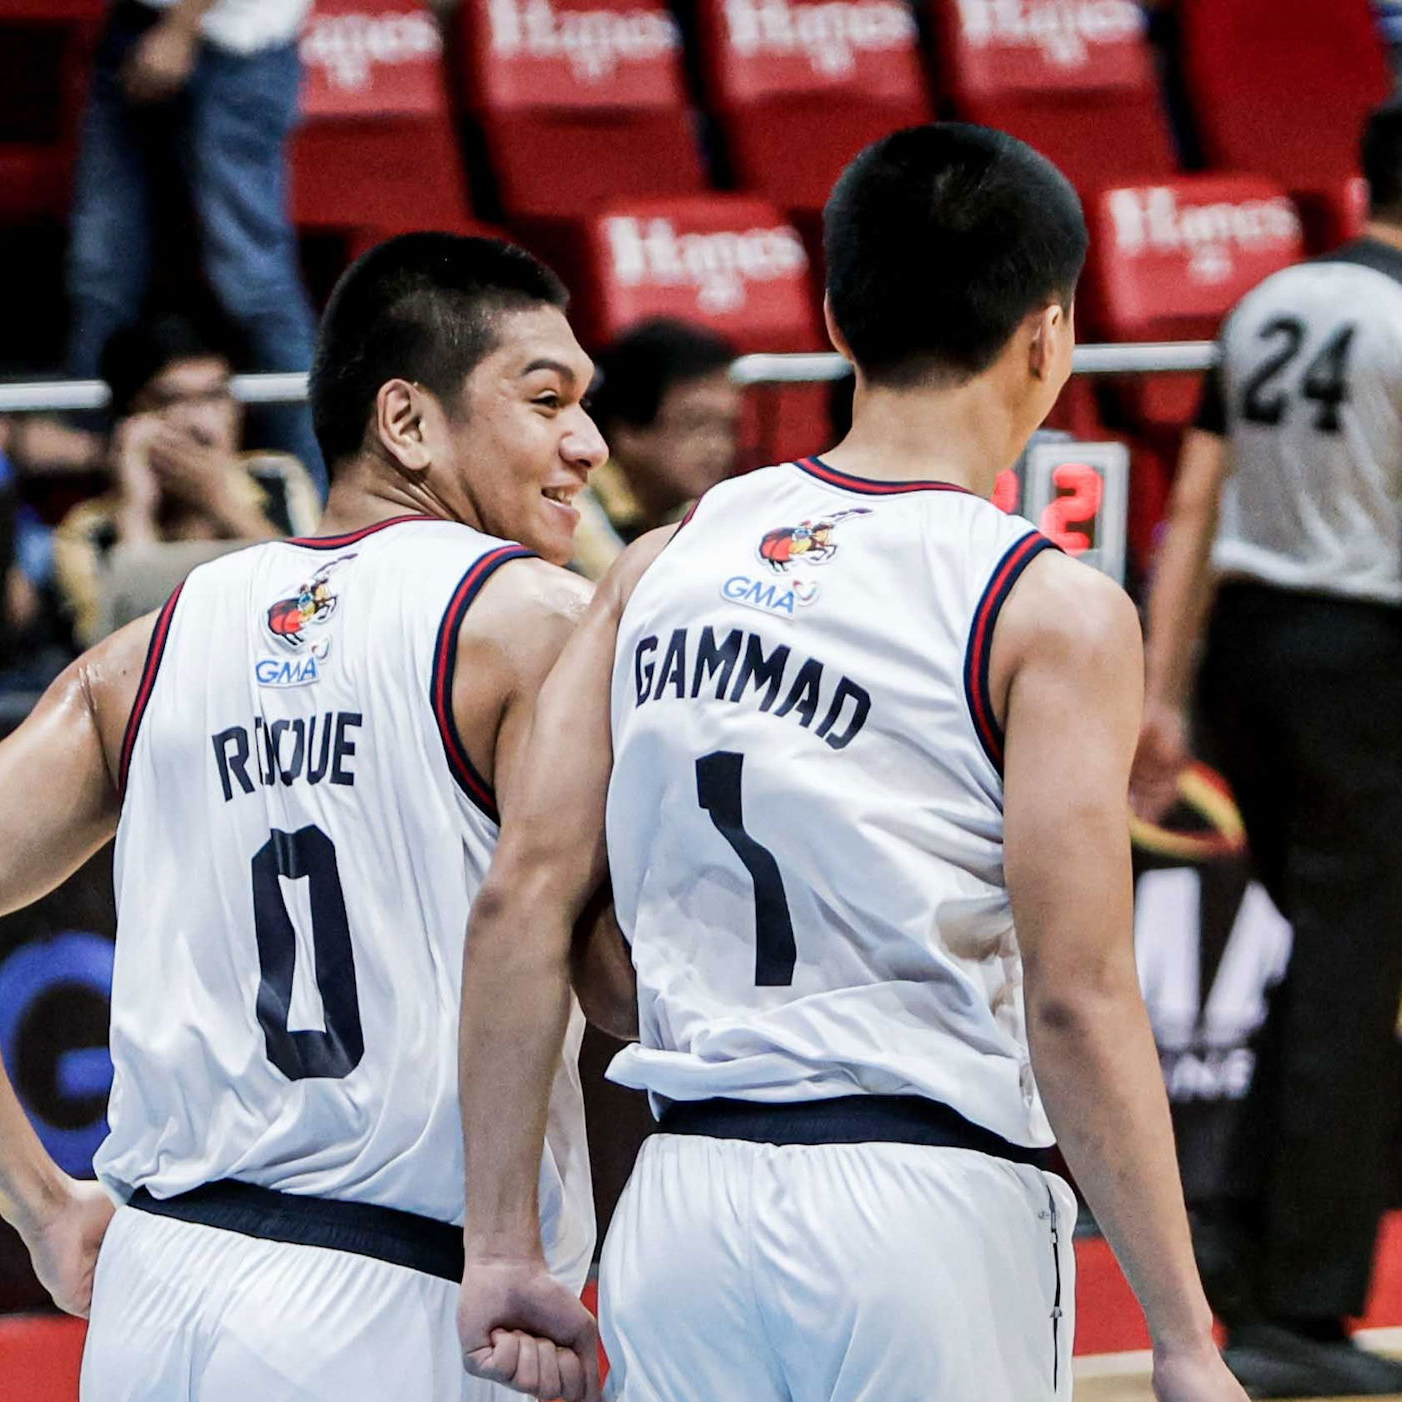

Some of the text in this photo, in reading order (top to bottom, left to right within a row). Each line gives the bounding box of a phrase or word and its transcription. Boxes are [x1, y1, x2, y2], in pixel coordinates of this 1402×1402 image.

[1242, 314, 1356, 433] 24
[722, 575, 795, 614] GMA
[255, 656, 318, 684] GMA
[635, 625, 872, 751] GAMMAD
[694, 750, 798, 987] 1
[250, 824, 366, 1080] 0
